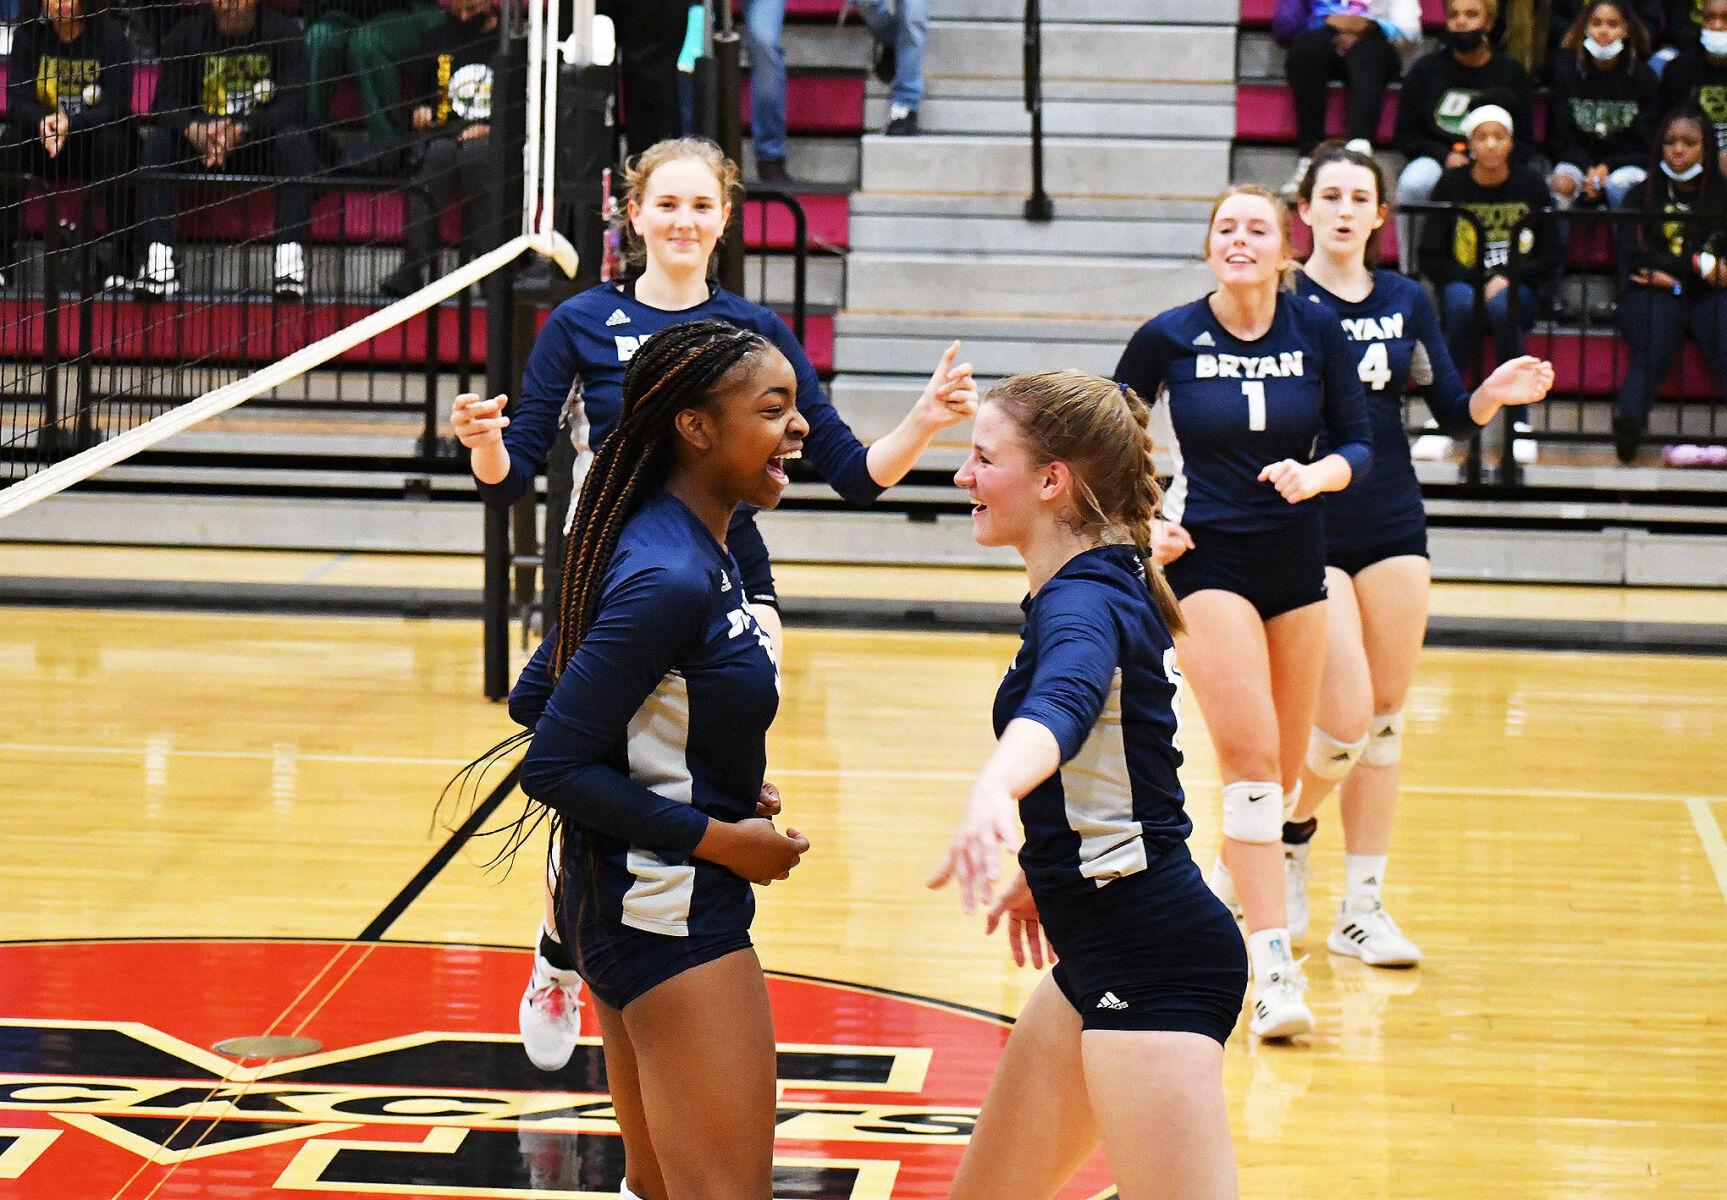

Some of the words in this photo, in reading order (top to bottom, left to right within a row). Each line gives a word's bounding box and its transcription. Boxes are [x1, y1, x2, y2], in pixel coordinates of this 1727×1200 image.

[1196, 350, 1304, 379] BRYAN
[1357, 342, 1392, 391] 4
[1242, 381, 1267, 432] 1
